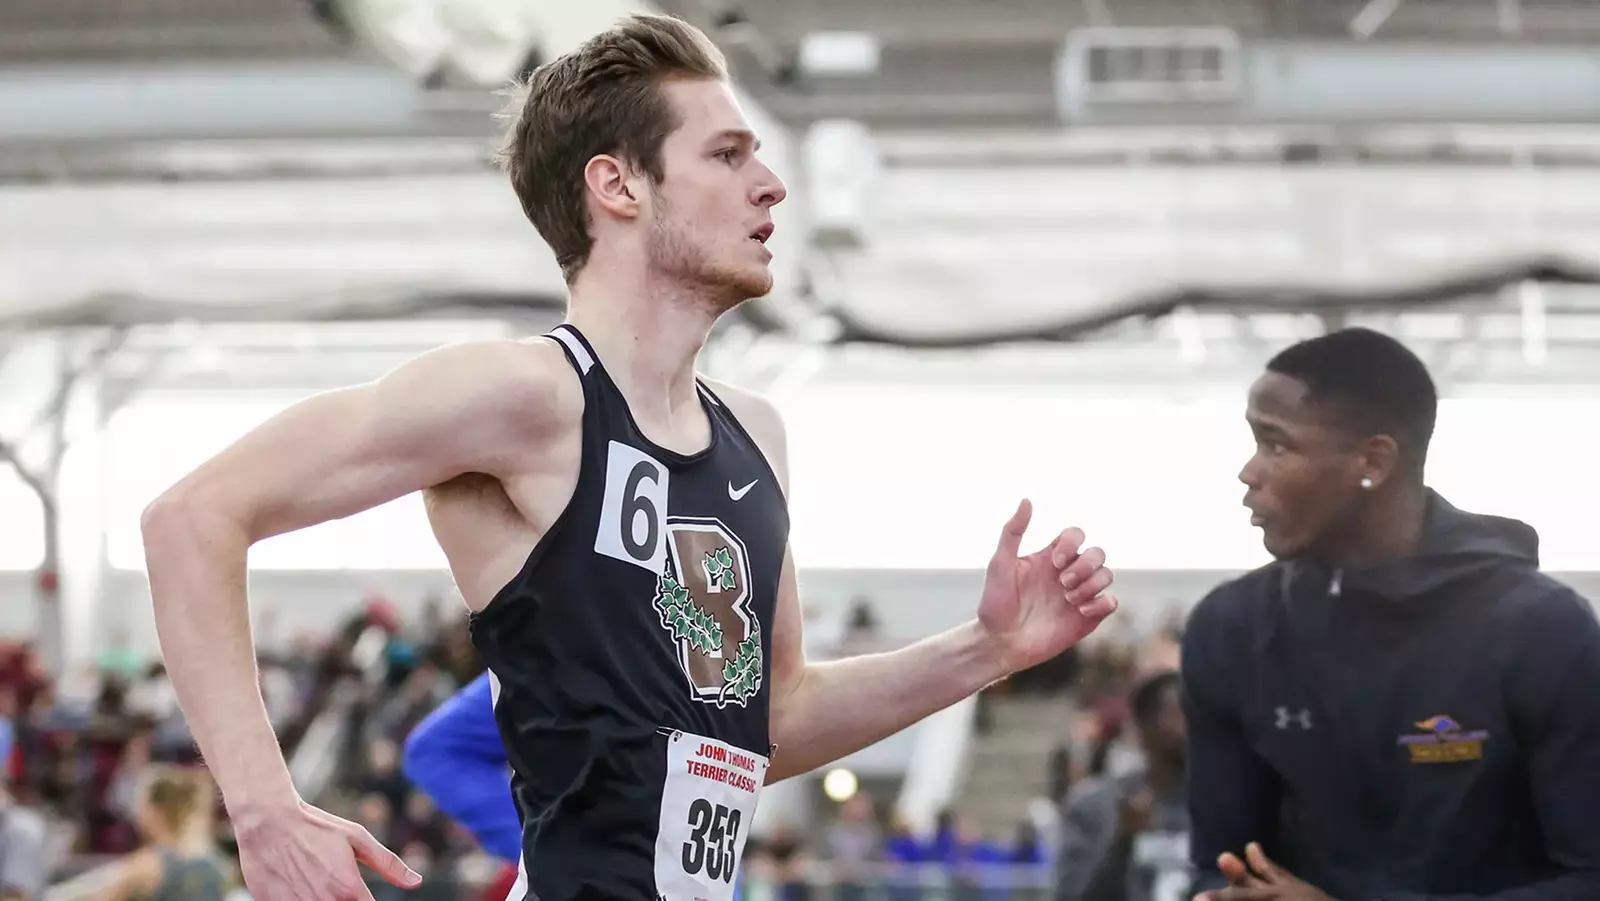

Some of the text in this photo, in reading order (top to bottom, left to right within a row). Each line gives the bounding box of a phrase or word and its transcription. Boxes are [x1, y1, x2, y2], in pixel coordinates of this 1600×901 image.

[620, 459, 660, 562] 6
[686, 760, 756, 793] TERRIER CLASSIC
[695, 743, 756, 773] JOHN THOMAS
[682, 798, 741, 884] 353
